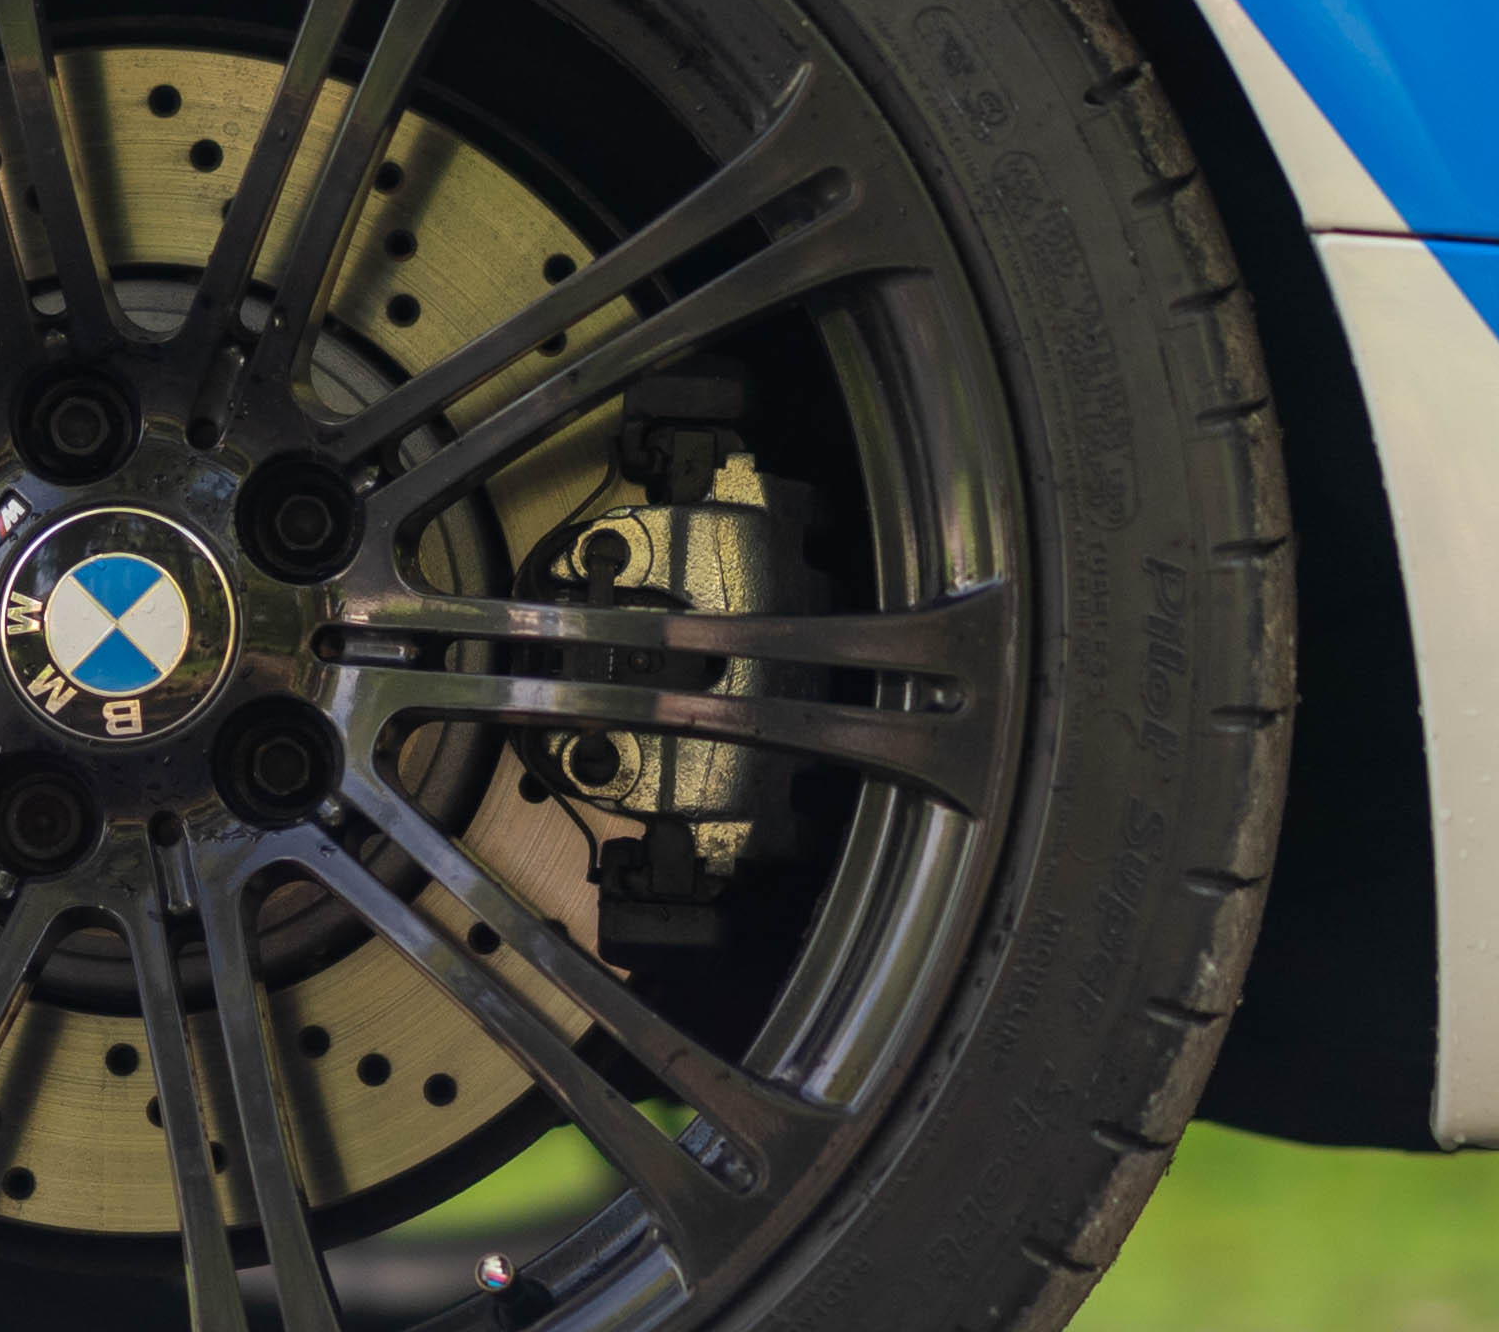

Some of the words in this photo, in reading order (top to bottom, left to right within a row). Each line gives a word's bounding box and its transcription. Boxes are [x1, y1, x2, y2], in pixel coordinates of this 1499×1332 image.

[1, 499, 26, 532] M
[6, 591, 143, 735] BMW
[1133, 552, 1187, 763] Pilot
[1050, 790, 1170, 1038] Super
